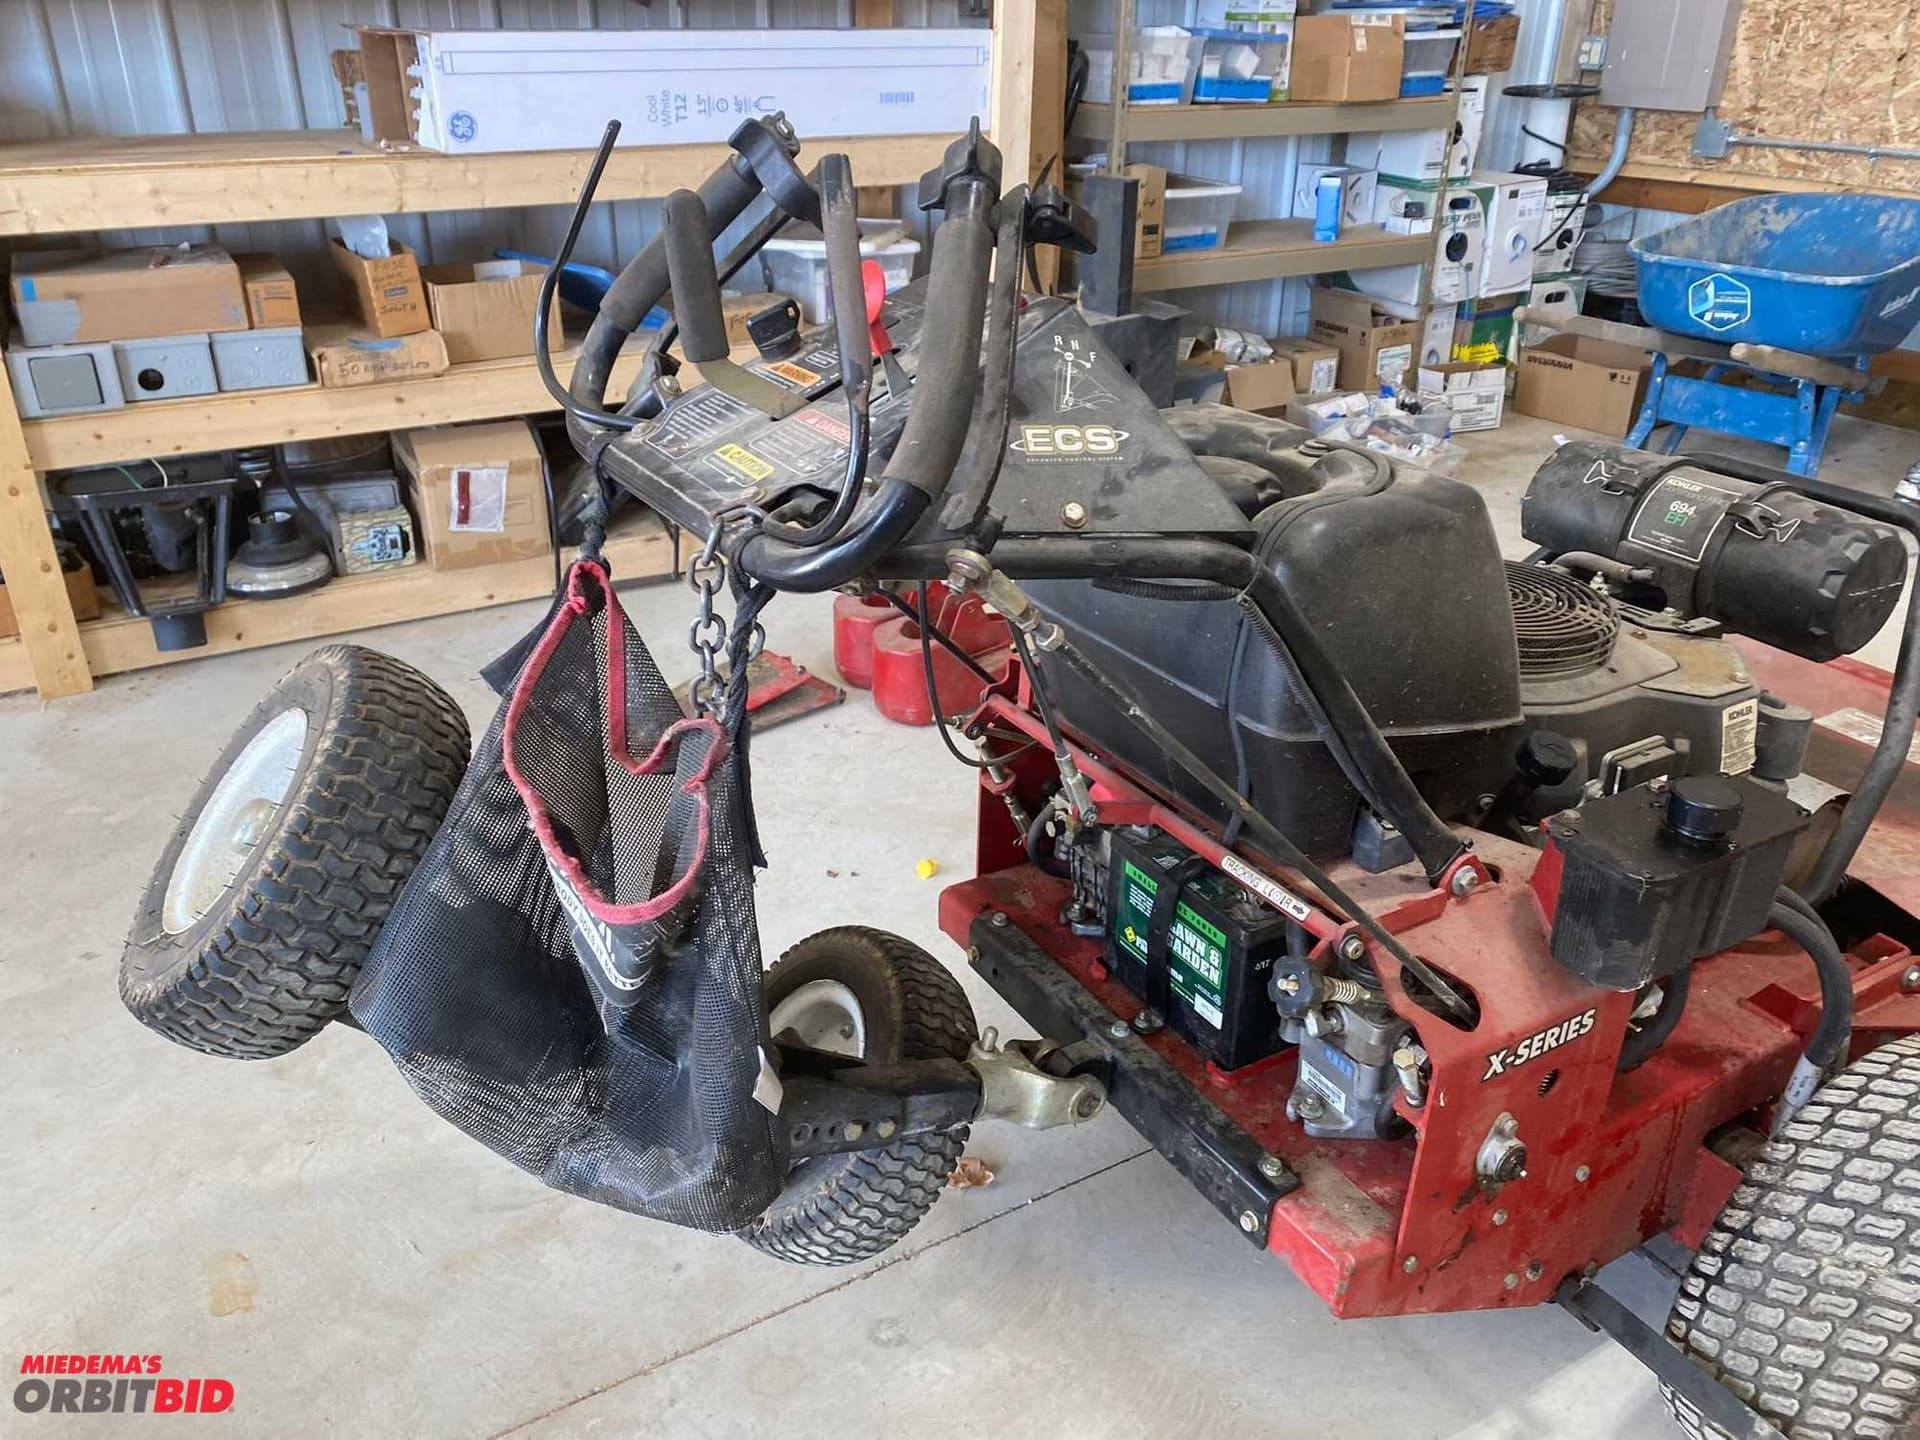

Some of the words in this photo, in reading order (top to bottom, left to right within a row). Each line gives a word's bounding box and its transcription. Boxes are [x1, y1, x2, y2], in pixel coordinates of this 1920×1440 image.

[645, 94, 658, 123] Cool
[659, 89, 672, 128] White
[674, 93, 689, 123] T12
[1053, 335, 1063, 346] R
[1089, 351, 1097, 362] F
[1526, 355, 1574, 371] SYLVANIA
[338, 362, 359, 377] 50
[1023, 425, 1119, 455] ECS
[728, 448, 771, 477] CAUTION
[1665, 479, 1704, 493] KOHLER
[1669, 500, 1697, 517] 694
[1664, 511, 1689, 528] EFI
[1727, 705, 1754, 721] KOHLER
[1482, 1008, 1597, 1082] X-SERIES
